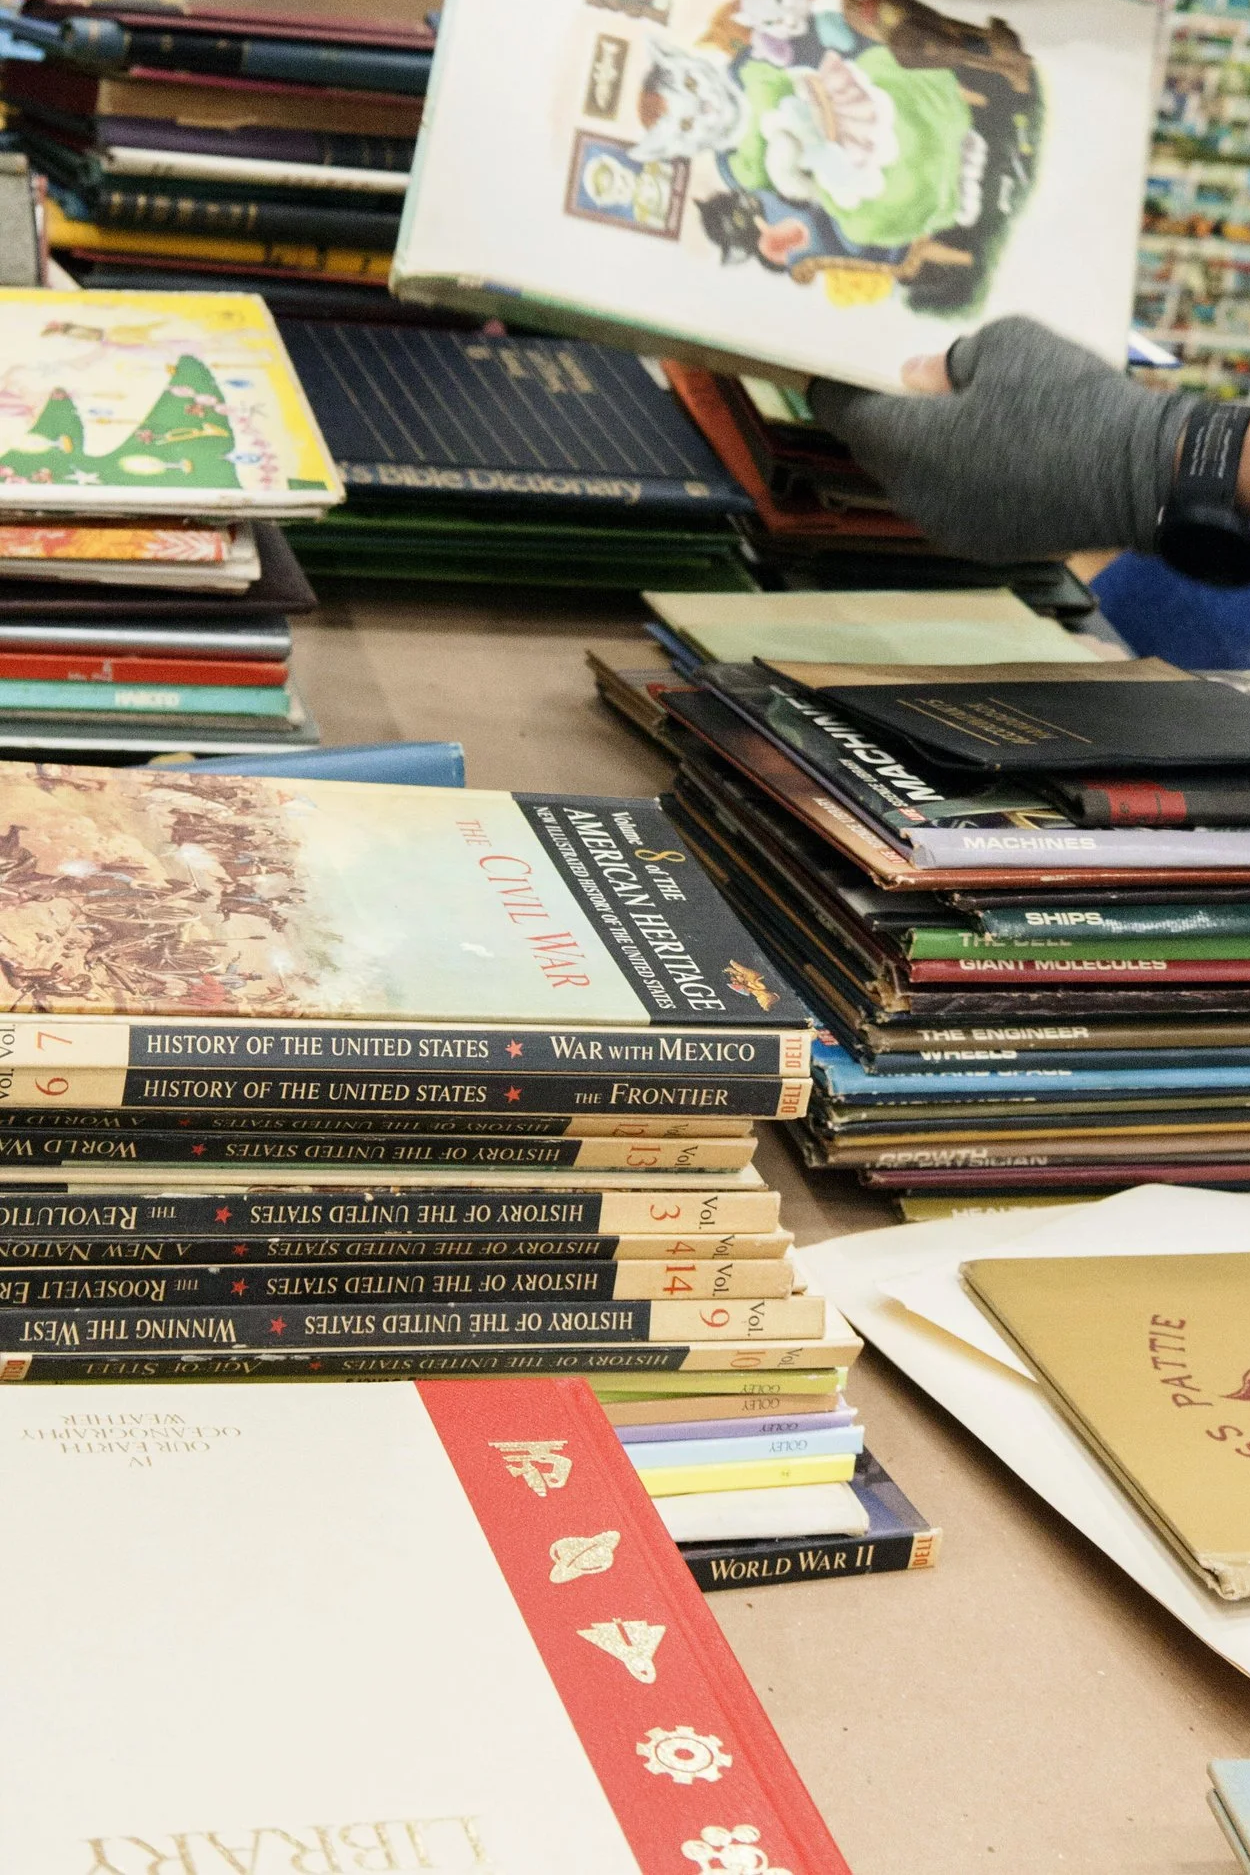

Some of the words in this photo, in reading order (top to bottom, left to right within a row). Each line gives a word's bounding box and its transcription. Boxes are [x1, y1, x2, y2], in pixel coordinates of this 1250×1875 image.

[467, 468, 641, 504] Dictionary
[533, 806, 556, 824] NEW
[455, 818, 493, 847] THE
[611, 811, 643, 846] Volume
[962, 836, 1097, 850] MACHINES
[545, 821, 590, 884] ILLUSTRATED
[634, 849, 686, 863] 8
[645, 864, 661, 879] of
[652, 875, 687, 902] THE
[580, 881, 613, 915] HISTORY
[562, 807, 656, 908] AMERICAN
[629, 911, 727, 1012] HERITAGE
[479, 854, 550, 925] CIVIL
[523, 930, 591, 989] WAR
[601, 913, 623, 928] OF
[1024, 912, 1104, 926] SHIPS
[609, 927, 635, 946] THE
[621, 945, 654, 980] UNITED
[959, 959, 1026, 971] GIANT
[1035, 959, 1168, 971] MOLECULES
[643, 977, 676, 1010] STATES
[36, 1031, 72, 1051] 7
[917, 1029, 966, 1042] THE
[972, 1027, 1090, 1040] ENGINEER
[146, 1034, 237, 1056] HISTORY
[246, 1035, 275, 1056] OF
[284, 1036, 323, 1056] THE
[330, 1036, 412, 1057] UNITED
[418, 1037, 490, 1059] STATES
[550, 1035, 604, 1060] WAR
[608, 1043, 654, 1061] WITH
[659, 1037, 756, 1062] MEXICO
[784, 1035, 803, 1070] DELL
[920, 1050, 1018, 1061] WHEELS
[34, 1077, 69, 1096] 6
[143, 1079, 235, 1100] HISTORY
[243, 1079, 273, 1099] OF
[279, 1081, 321, 1101] THE
[329, 1082, 410, 1102] UNITED
[415, 1084, 488, 1104] STATES
[574, 1091, 602, 1105] THE
[609, 1083, 730, 1107] FRONTIER
[781, 1083, 803, 1114] DELL
[27, 1115, 122, 1128] WORLD
[130, 1117, 147, 1127] A
[212, 1117, 282, 1129] STATES
[292, 1118, 374, 1131] UNITED
[385, 1120, 420, 1132] THE
[434, 1121, 460, 1132] OF
[466, 1121, 549, 1133] HISTORY
[43, 1139, 138, 1159] WORLD
[225, 1143, 298, 1158] STATES
[304, 1144, 385, 1159] UNITED
[394, 1146, 433, 1160] THE
[440, 1147, 467, 1161] OF
[471, 1147, 561, 1162] HISTORY
[626, 1146, 661, 1166] 13
[879, 1148, 989, 1164] GROWTH
[146, 1206, 178, 1220] THE
[249, 1206, 322, 1224] STATES
[329, 1205, 410, 1223] UNITED
[417, 1205, 457, 1223] THE
[464, 1204, 491, 1222] OF
[498, 1204, 584, 1222] HISTORY
[649, 1204, 681, 1221] 3
[698, 1195, 718, 1230] Vol.
[101, 1243, 162, 1261] NEW
[175, 1242, 192, 1257] A
[266, 1242, 339, 1257] STATES
[347, 1242, 425, 1257] UNITED
[434, 1242, 474, 1256] THE
[480, 1242, 508, 1255] OF
[514, 1241, 600, 1255] HISTORY
[665, 1240, 696, 1255] 4
[175, 1278, 200, 1292] THE
[265, 1277, 338, 1295] STATES
[344, 1276, 424, 1293] UNITED
[432, 1275, 472, 1293] THE
[480, 1274, 507, 1292] OF
[512, 1273, 598, 1291] HISTORY
[663, 1264, 696, 1295] 14
[712, 1263, 733, 1297] Vol.
[38, 1279, 166, 1303] ROOSEVELT
[304, 1315, 376, 1335] STATES
[381, 1314, 461, 1333] UNITED
[469, 1313, 509, 1332] THE
[516, 1312, 543, 1331] OF
[547, 1311, 634, 1331] HISTORY
[699, 1308, 730, 1328] 9
[747, 1301, 765, 1337] Vol.
[19, 1320, 81, 1345] WEST
[86, 1319, 129, 1341] THE
[135, 1317, 237, 1343] WINNING
[168, 1361, 196, 1375] OF
[202, 1361, 263, 1375] AGE
[341, 1358, 413, 1371] STATES
[419, 1355, 498, 1369] UNITED
[506, 1355, 547, 1368] THE
[556, 1353, 582, 1367] OF
[589, 1353, 670, 1367] HISTORY
[730, 1350, 766, 1369] 10
[1148, 1314, 1214, 1408] PATTIE
[83, 1361, 158, 1376] STEEL
[741, 1397, 781, 1411] GOLEY
[60, 1413, 186, 1426] WEATHER
[759, 1422, 799, 1433] GOLEY
[21, 1426, 241, 1440] OCEANOGRAPHY
[61, 1441, 148, 1454] EARTH
[156, 1441, 211, 1453] OUR
[769, 1439, 808, 1453] GOLEY
[710, 1557, 792, 1581] WORLD
[798, 1549, 847, 1573] WAR
[855, 1545, 876, 1567] II
[911, 1535, 934, 1568] DELL
[79, 1815, 484, 1875] LIBRARY
